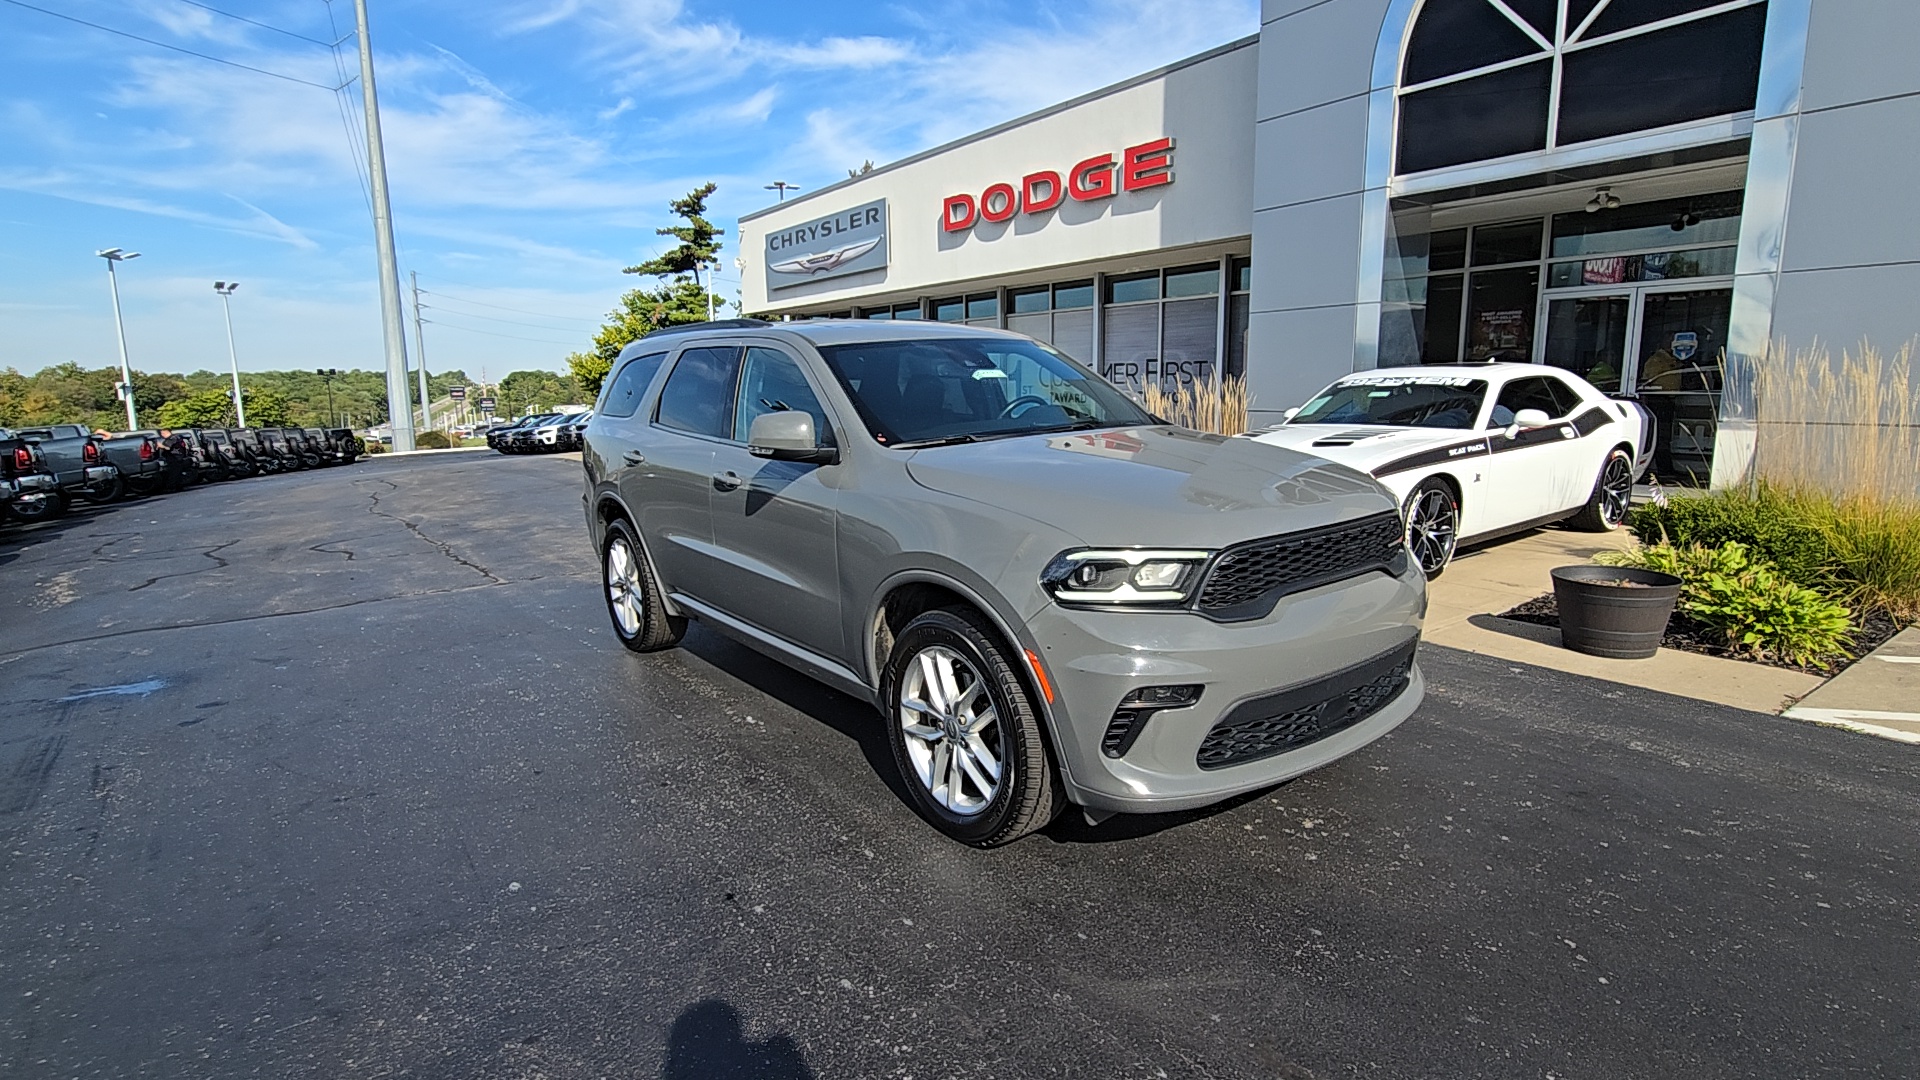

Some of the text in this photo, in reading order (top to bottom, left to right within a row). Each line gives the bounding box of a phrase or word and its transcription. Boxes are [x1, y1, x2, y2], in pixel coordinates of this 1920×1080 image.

[943, 137, 1175, 232] DODGE
[769, 207, 880, 251] CHRYSLER
[1405, 376, 1473, 387] HEMI
